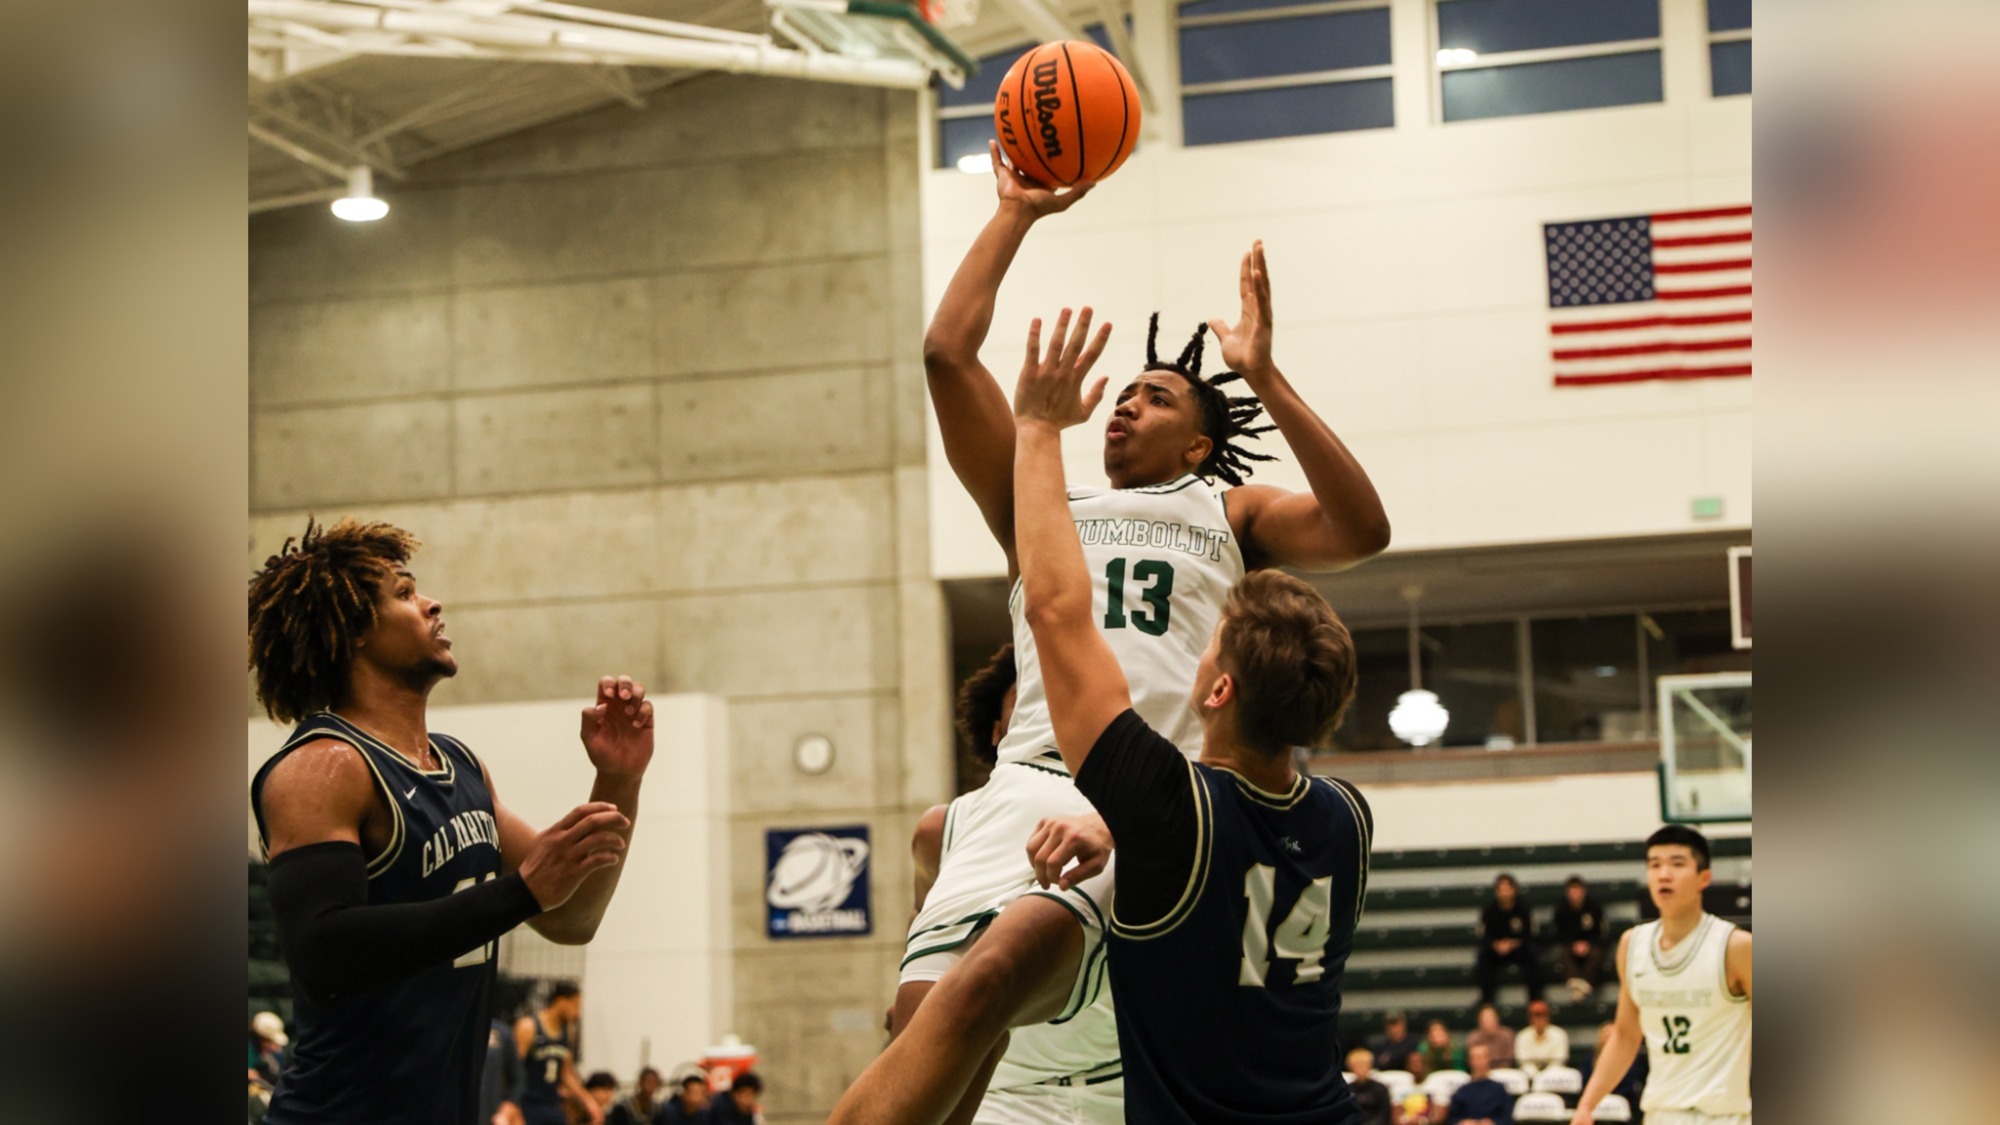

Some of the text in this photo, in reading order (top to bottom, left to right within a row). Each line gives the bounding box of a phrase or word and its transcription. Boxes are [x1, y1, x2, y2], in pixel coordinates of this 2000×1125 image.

[1033, 58, 1063, 159] Wilson
[1104, 557, 1175, 636] 13
[422, 825, 455, 878] CAL
[1238, 861, 1333, 987] 14
[1662, 1015, 1691, 1054] 12
